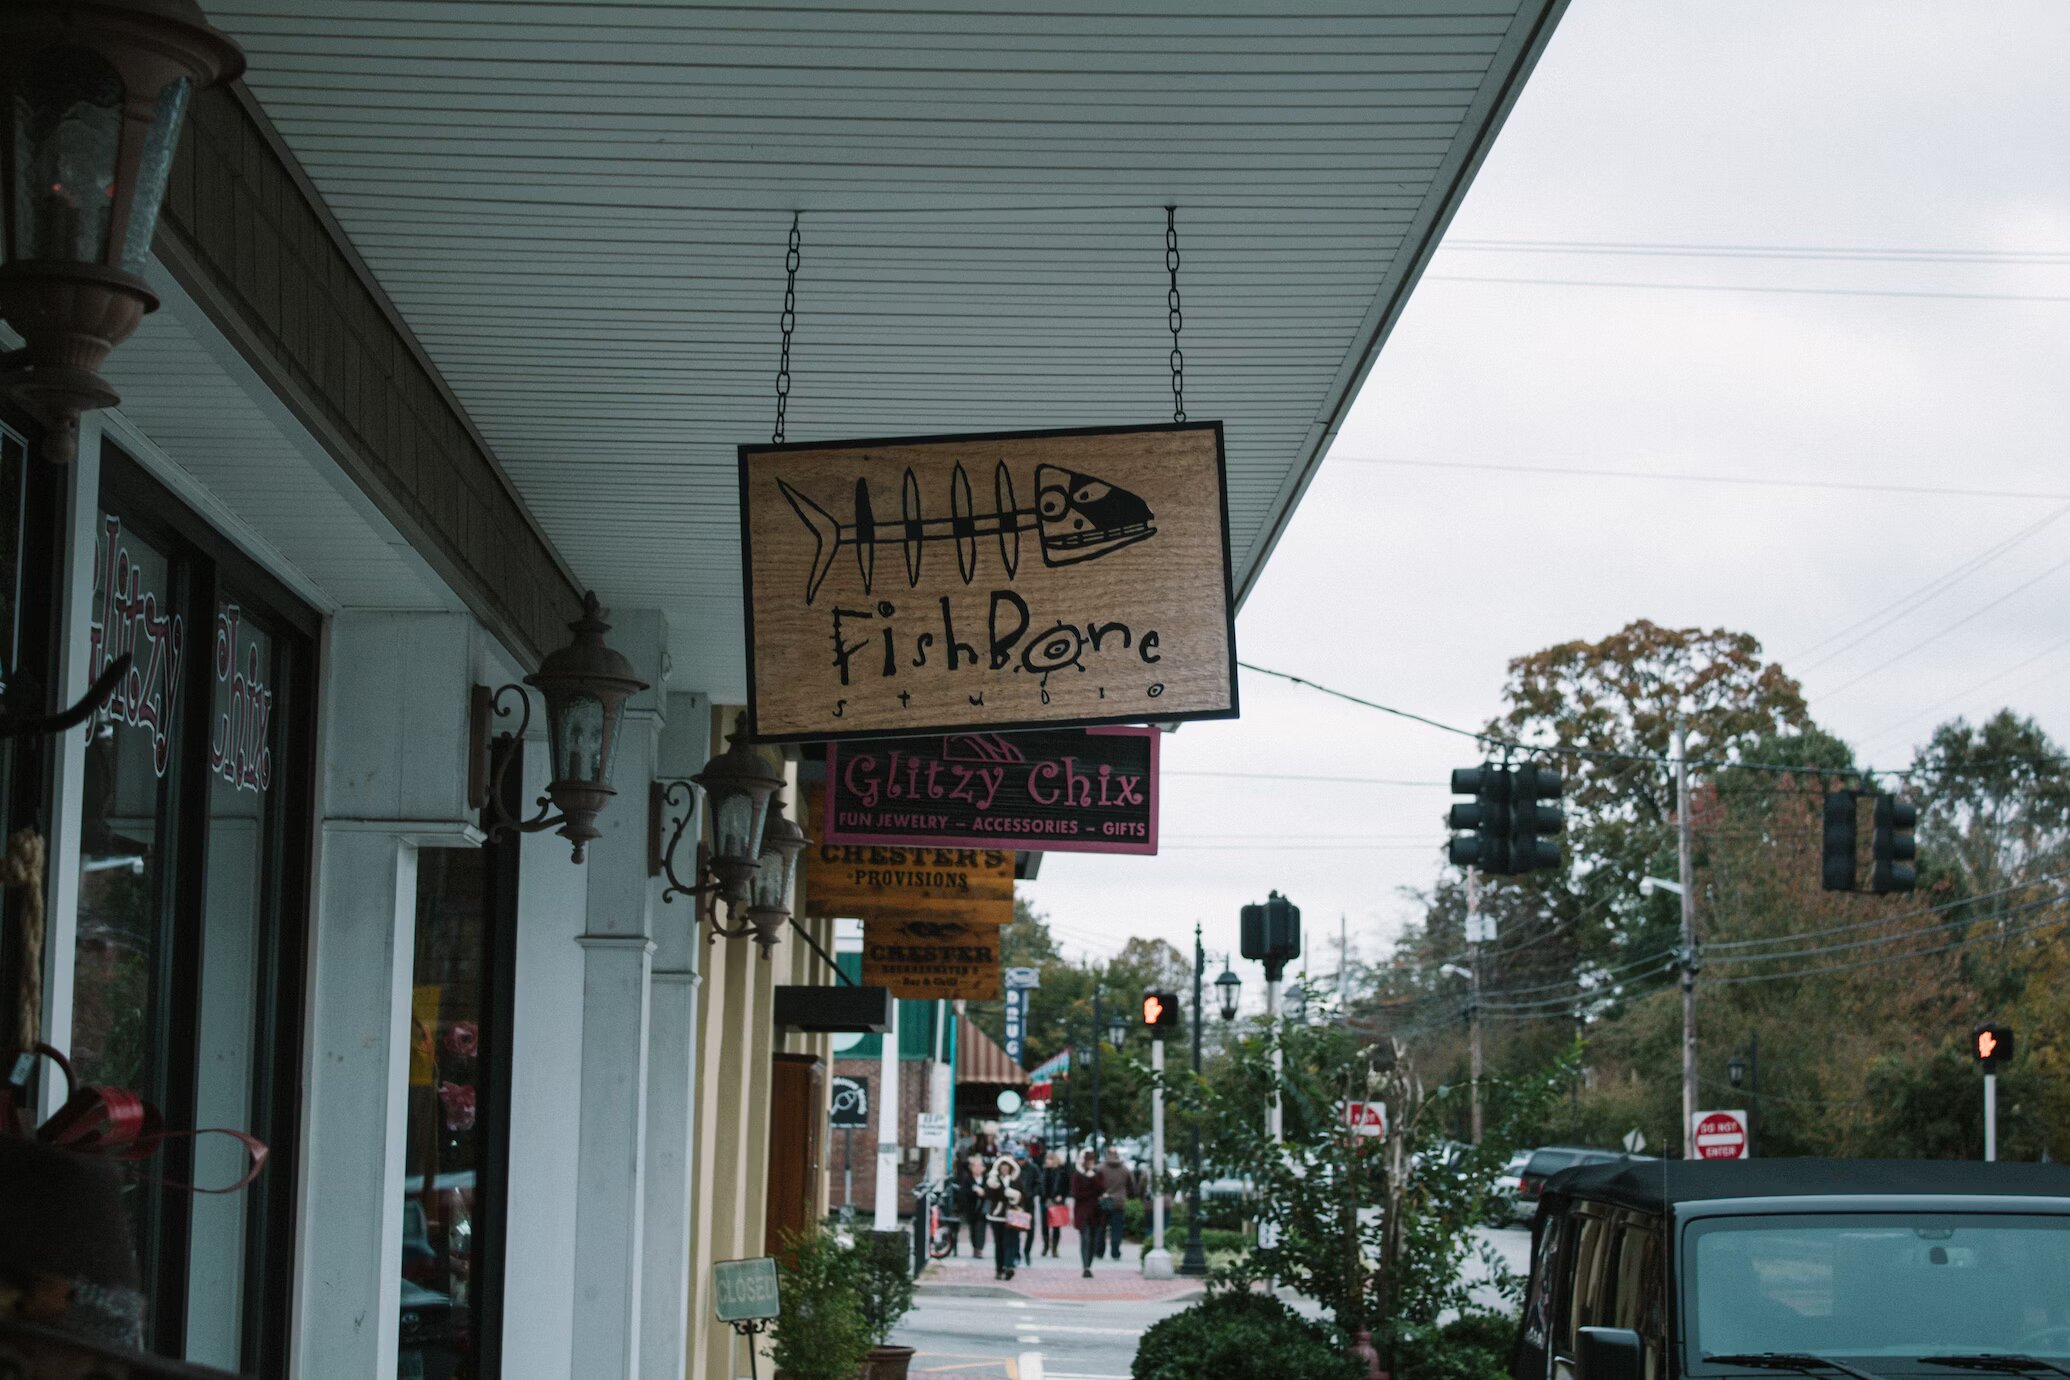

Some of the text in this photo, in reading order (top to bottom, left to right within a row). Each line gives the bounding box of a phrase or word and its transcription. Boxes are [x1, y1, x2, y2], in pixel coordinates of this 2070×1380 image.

[85, 516, 183, 778] litzy
[829, 590, 1161, 686] FishBone
[844, 752, 1144, 810] Glitzy Chix
[839, 812, 873, 827] FUN
[876, 815, 949, 830] JEWELRY
[972, 819, 1079, 834] ACCESSORIES
[1102, 821, 1146, 837] GIFTS
[820, 844, 1004, 868] CHESTER'S
[854, 870, 968, 888] PROVISIONS
[1717, 1121, 1738, 1132] NOT
[1705, 1146, 1737, 1158] ENTER
